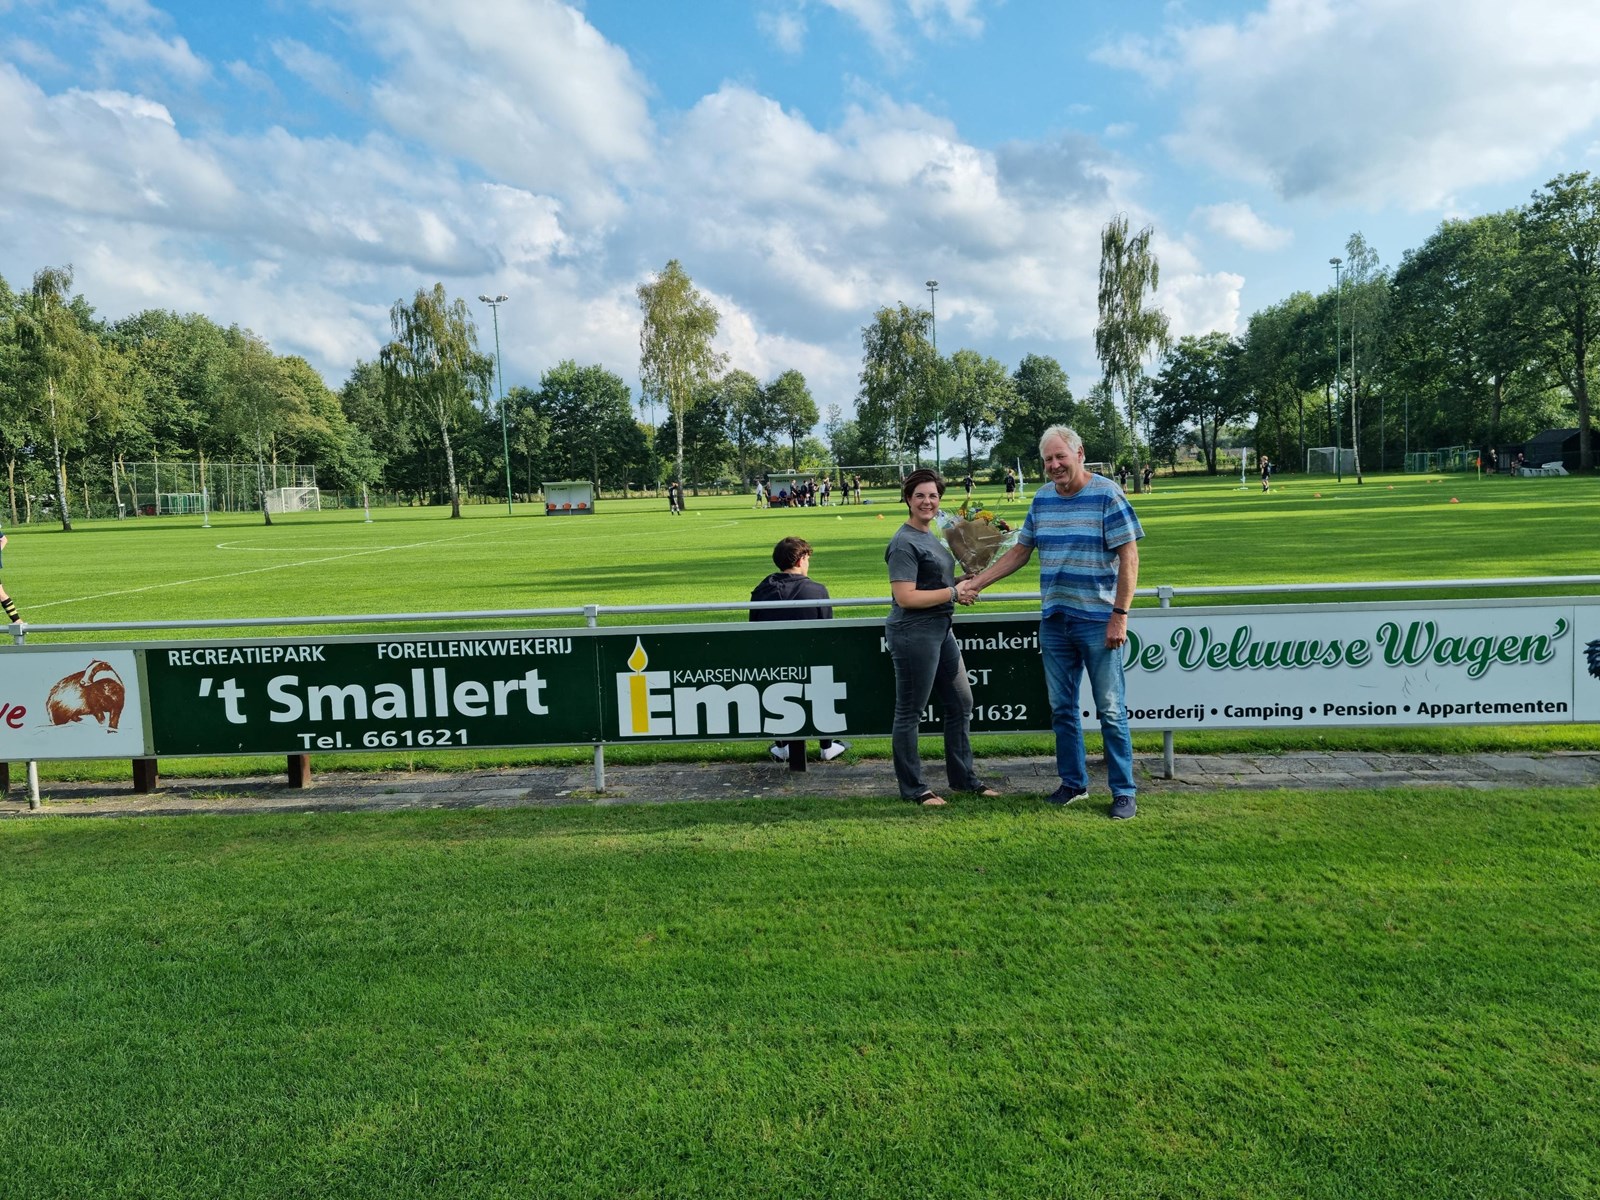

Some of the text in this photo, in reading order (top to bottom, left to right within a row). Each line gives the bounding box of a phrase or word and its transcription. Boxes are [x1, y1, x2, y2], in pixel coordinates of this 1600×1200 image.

[168, 645, 326, 666] RECREATIEPARK
[377, 638, 573, 660] FORELLENKWEKERIJ
[1170, 624, 1371, 671] Veluwse
[673, 666, 808, 684] KAARSENMAKERIJ
[266, 667, 549, 723] Smallert
[1223, 702, 1304, 721] Camping
[1323, 701, 1397, 717] Pension
[1416, 700, 1568, 719] Appartementen
[297, 728, 468, 749] Tel. 661621
